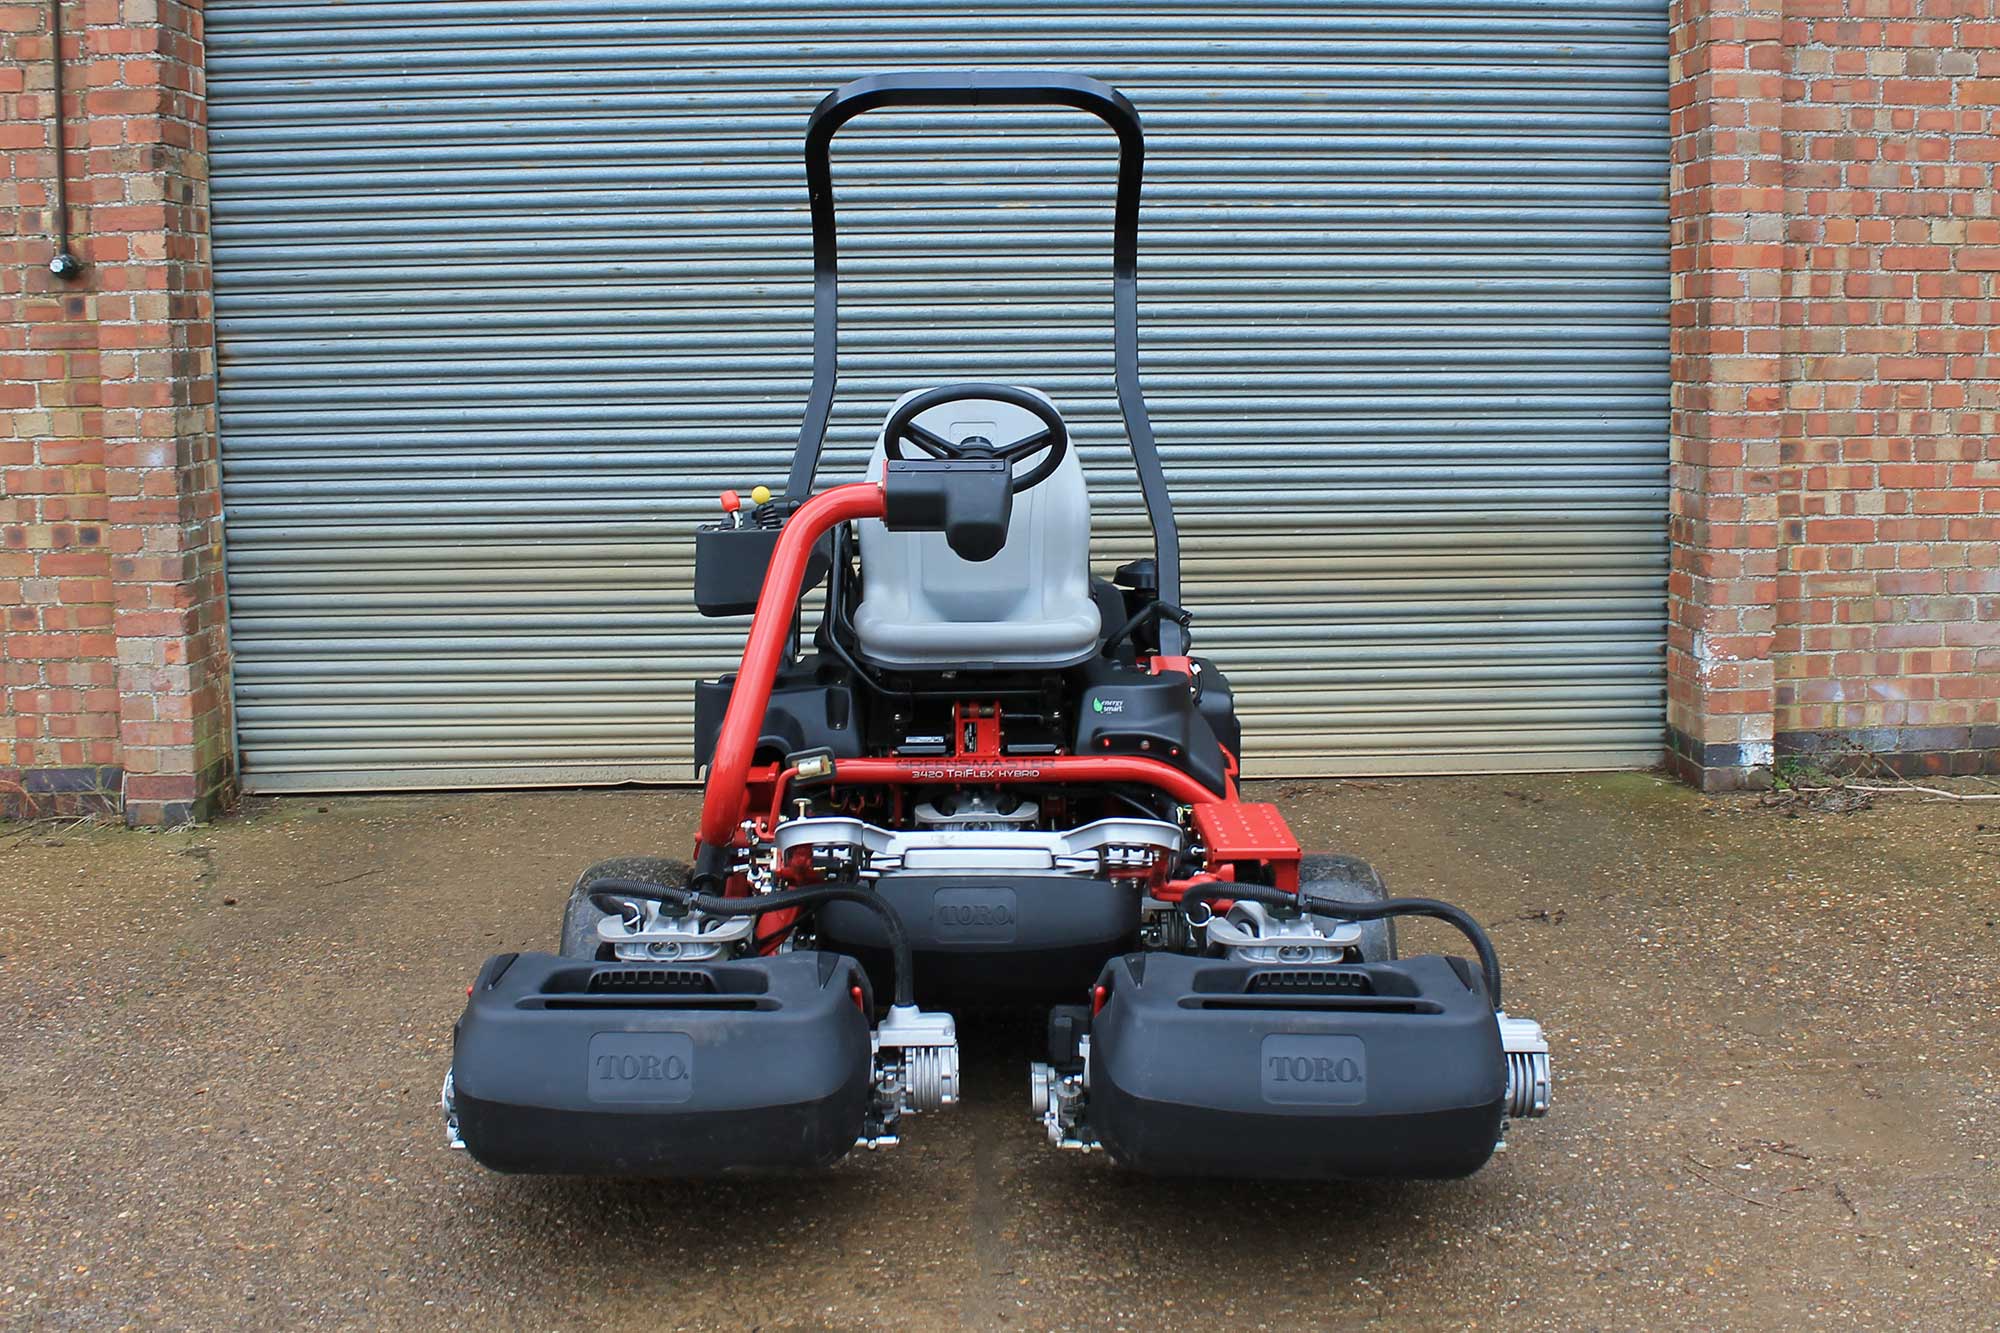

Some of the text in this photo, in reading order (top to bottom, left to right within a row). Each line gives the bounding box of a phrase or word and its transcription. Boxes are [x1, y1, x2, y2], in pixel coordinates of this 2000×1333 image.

[896, 758, 1056, 769] GREENSMASTER
[911, 770, 944, 778] 3420
[998, 769, 1040, 777] HYBRID
